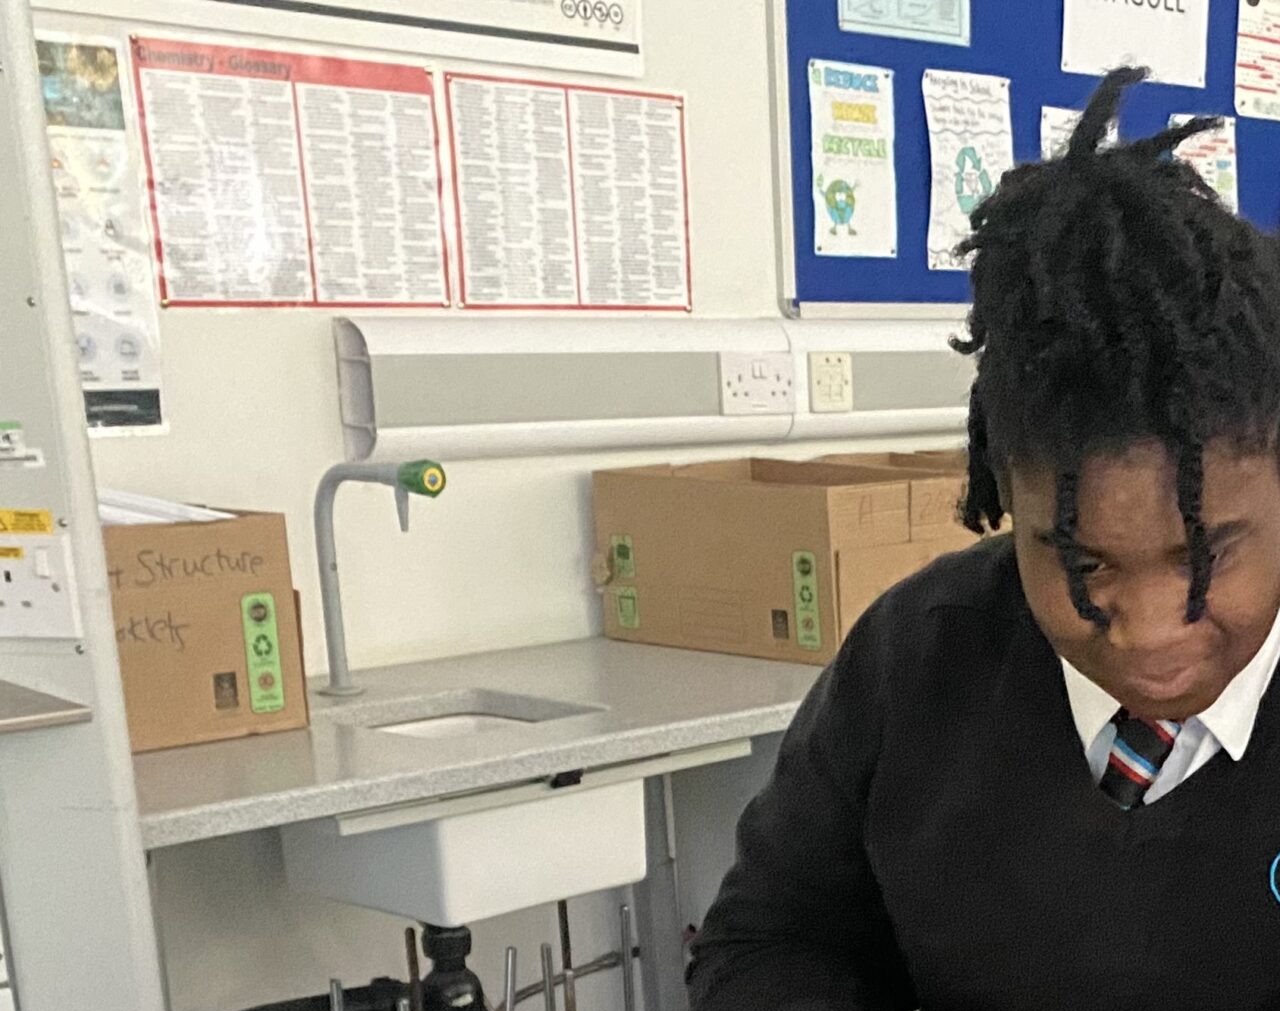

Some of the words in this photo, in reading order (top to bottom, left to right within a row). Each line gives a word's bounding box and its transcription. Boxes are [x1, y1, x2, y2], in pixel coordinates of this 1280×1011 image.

[138, 45, 214, 73] Chemistry
[228, 55, 291, 81] Glossary
[135, 548, 264, 587] Structure
